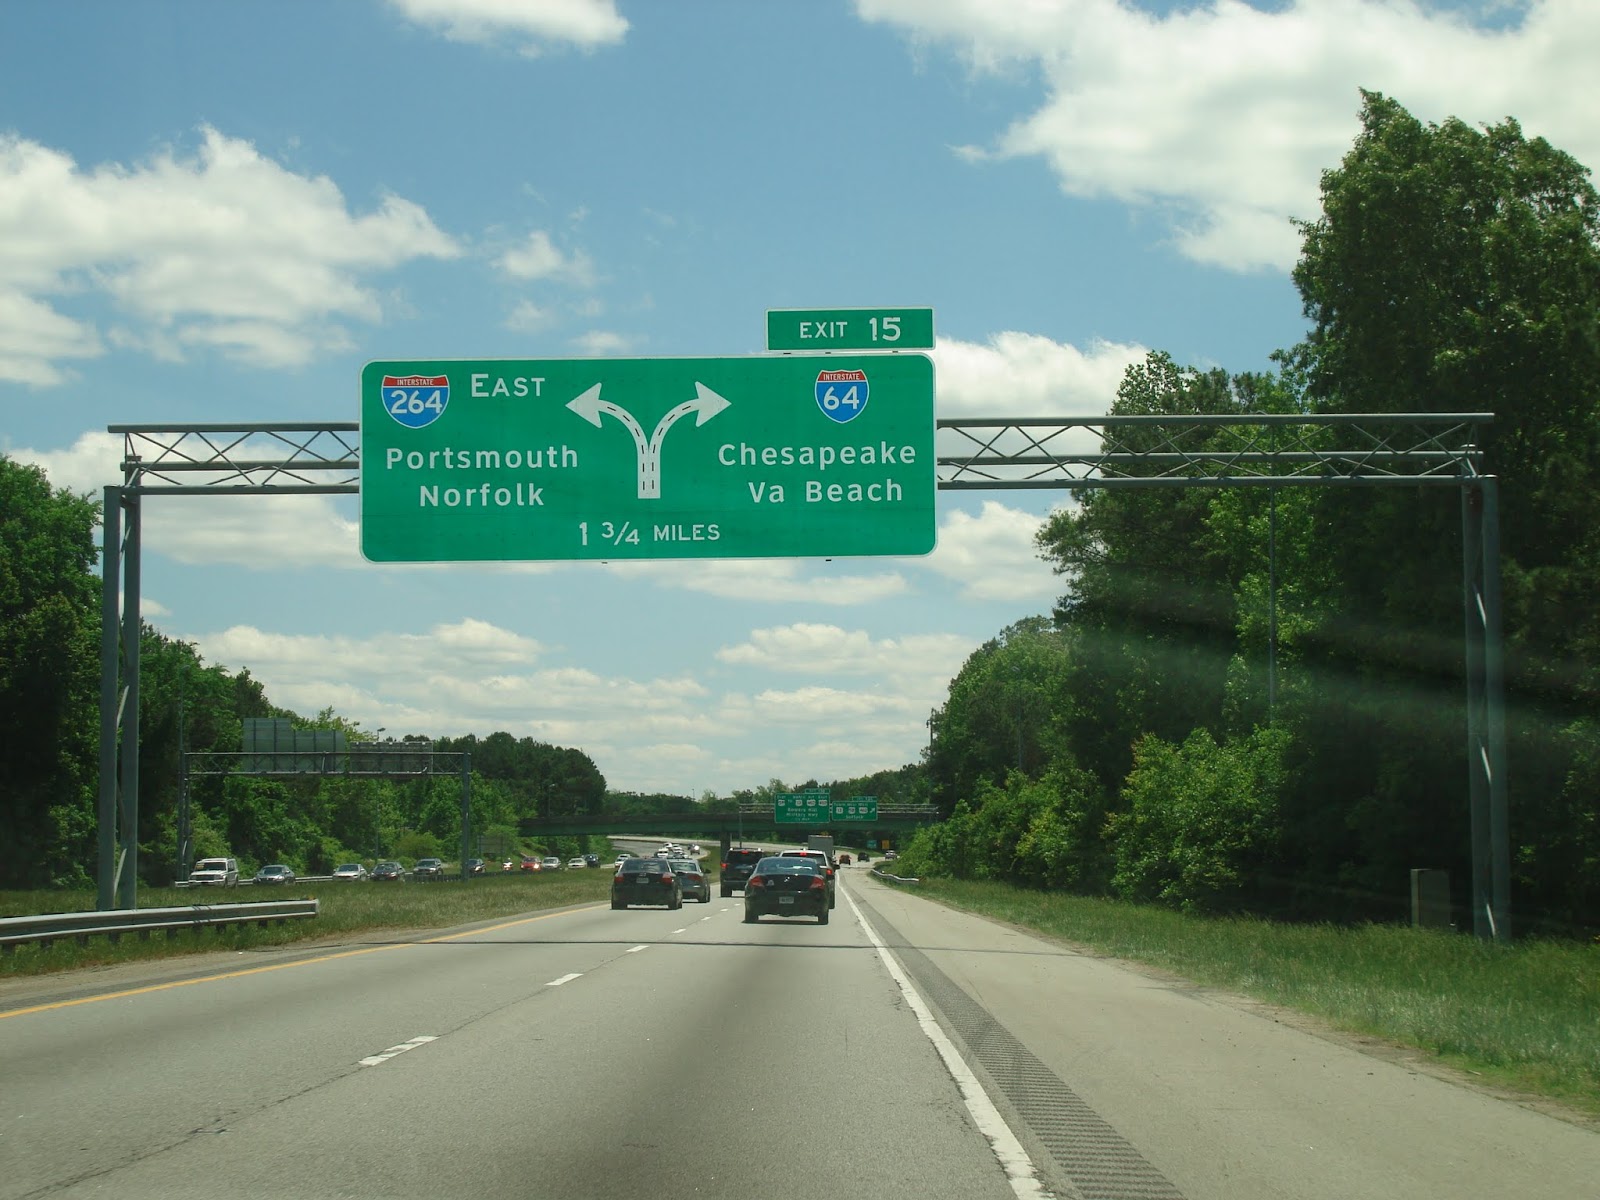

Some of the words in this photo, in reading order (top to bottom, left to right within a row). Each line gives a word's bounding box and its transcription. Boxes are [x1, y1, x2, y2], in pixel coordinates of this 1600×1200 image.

[801, 322, 848, 338] EXIT
[869, 318, 901, 340] 15
[396, 378, 434, 386] INTERSTATE
[471, 373, 545, 397] EAST
[823, 373, 860, 381] INTERSTATE
[390, 390, 443, 414] 264
[823, 385, 859, 411] 64
[387, 446, 577, 469] Portsmouth
[718, 442, 916, 470] Chesapeake
[420, 484, 544, 507] Norfolk
[748, 482, 784, 503] Va
[806, 479, 902, 502] Beach
[579, 522, 587, 546] 1
[602, 521, 640, 545] 3/4
[654, 525, 720, 541] MILES
